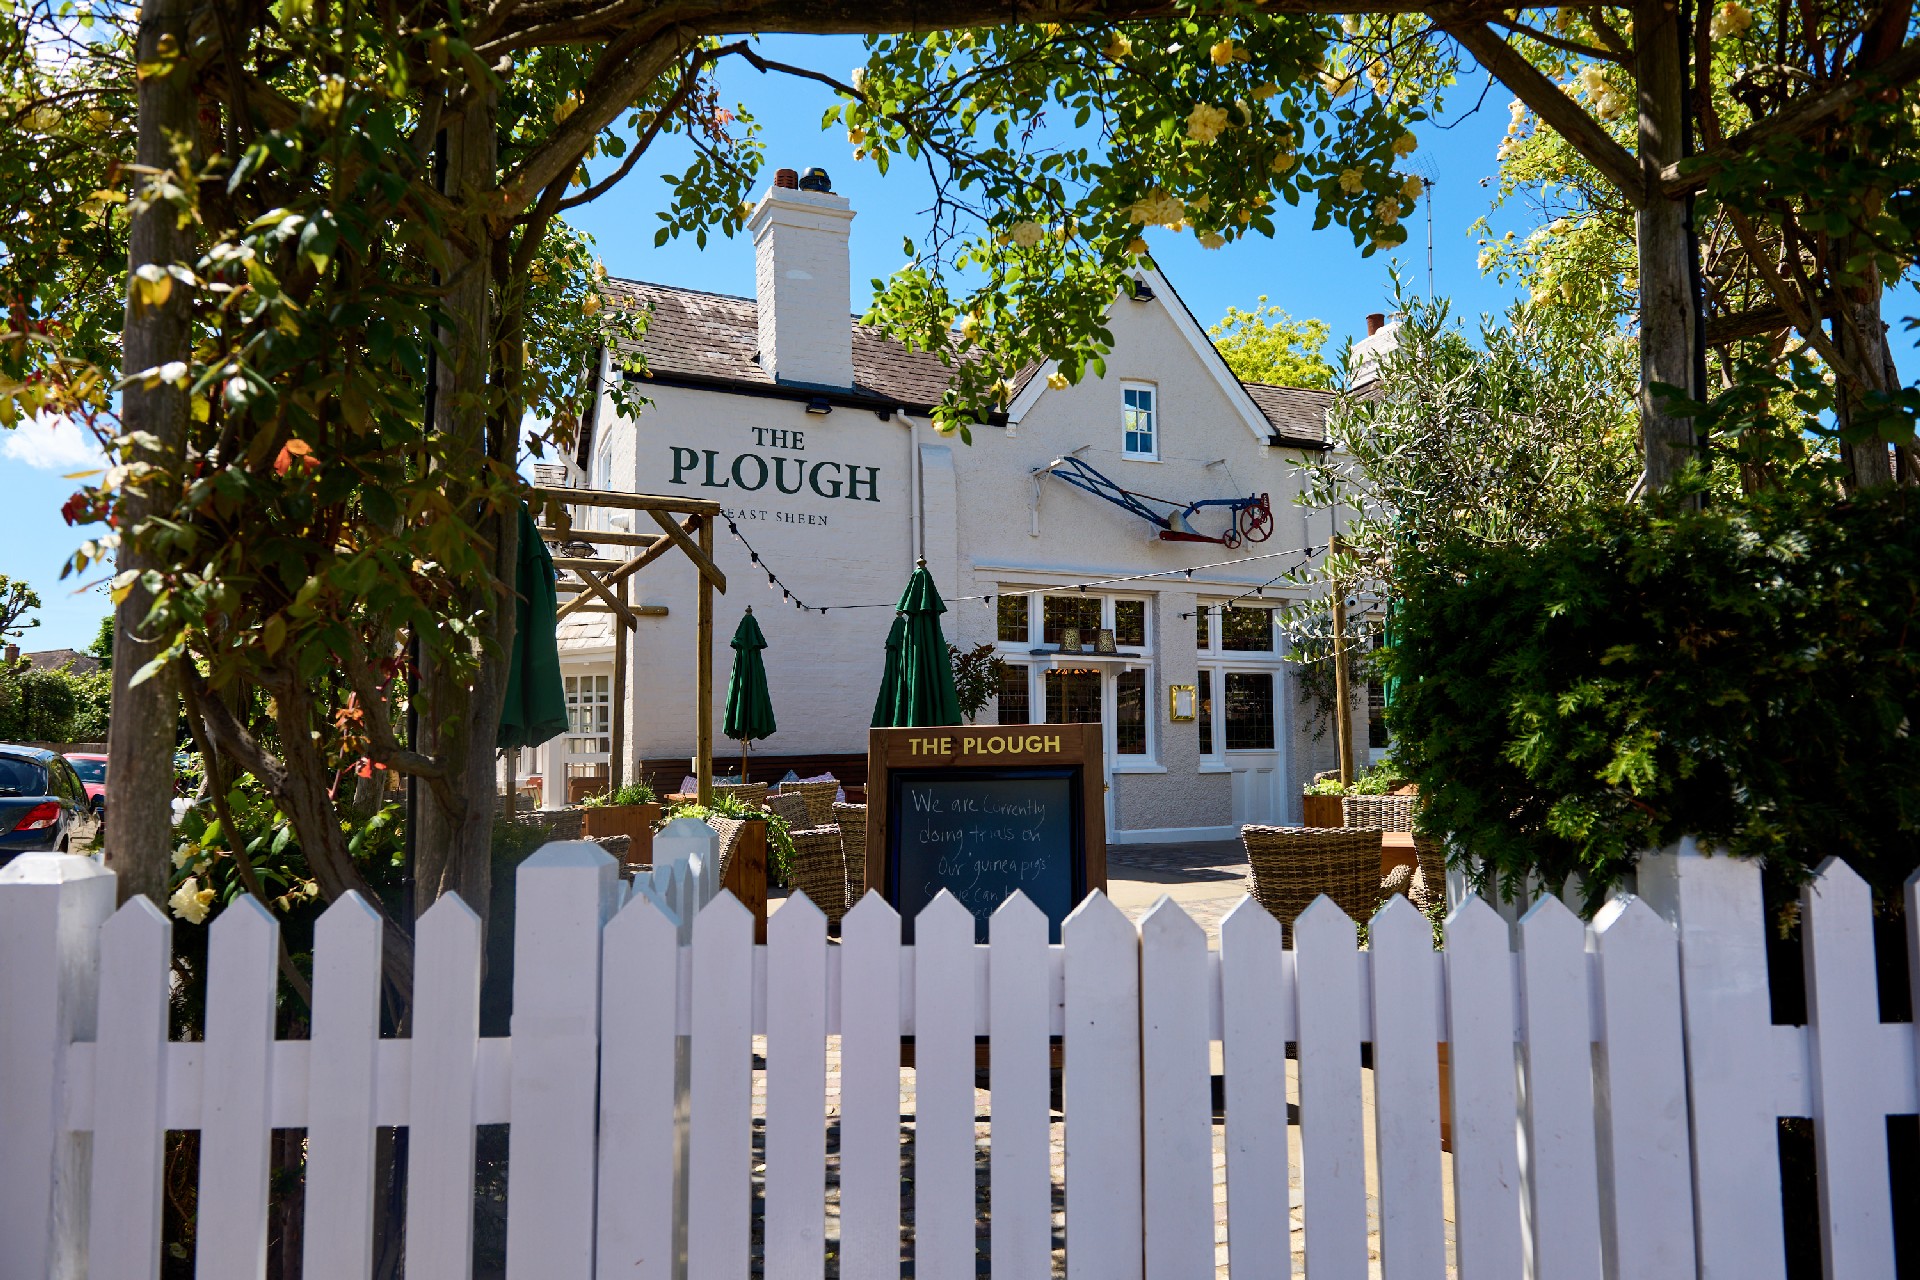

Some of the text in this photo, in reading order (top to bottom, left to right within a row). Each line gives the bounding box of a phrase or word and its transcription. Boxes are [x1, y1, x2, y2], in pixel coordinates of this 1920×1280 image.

[751, 426, 805, 451] THE
[668, 445, 881, 502] PLOUGH
[727, 508, 828, 526] EAST SHEEN
[908, 735, 1061, 755] THE PLOUGH
[911, 788, 944, 813] We
[951, 798, 978, 812] are
[919, 818, 1041, 861] doing trials on
